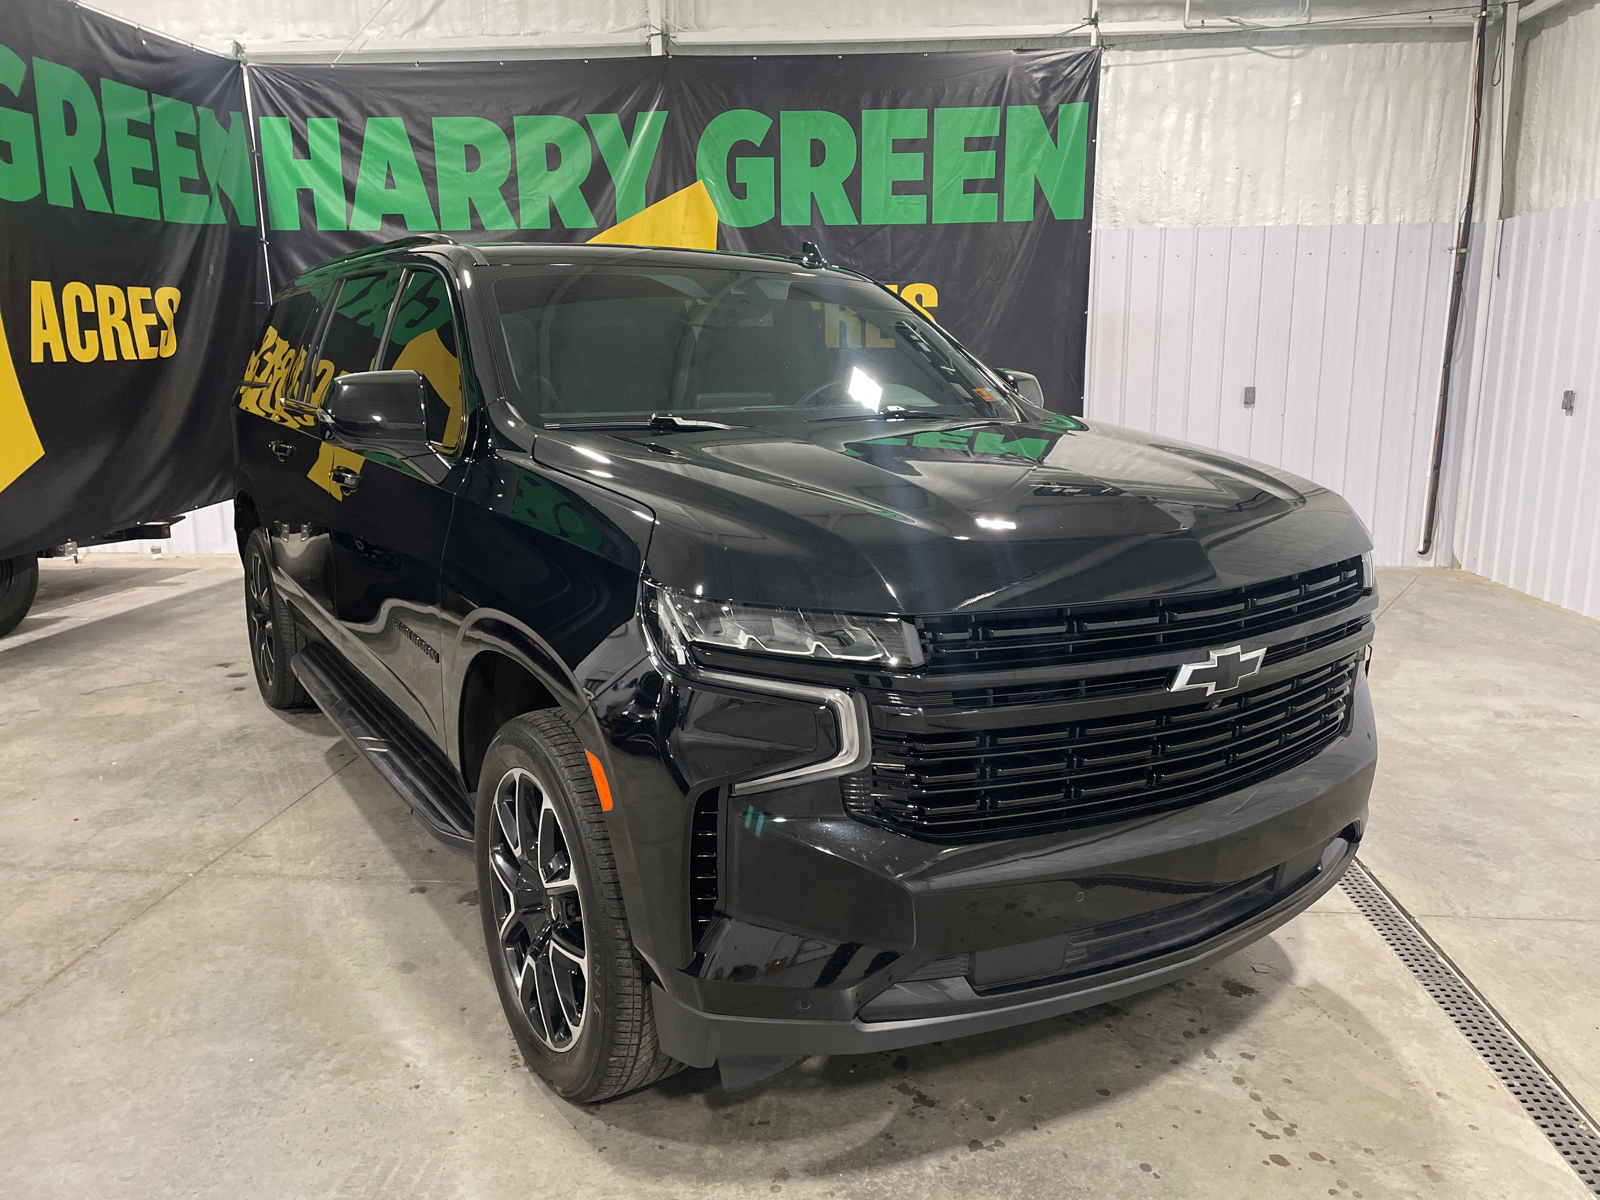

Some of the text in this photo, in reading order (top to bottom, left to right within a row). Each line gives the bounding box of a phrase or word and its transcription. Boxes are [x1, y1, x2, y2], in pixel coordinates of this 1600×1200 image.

[0, 44, 256, 227] GREEN
[259, 102, 1089, 231] HARRY GREEN
[30, 280, 181, 364] ACRES
